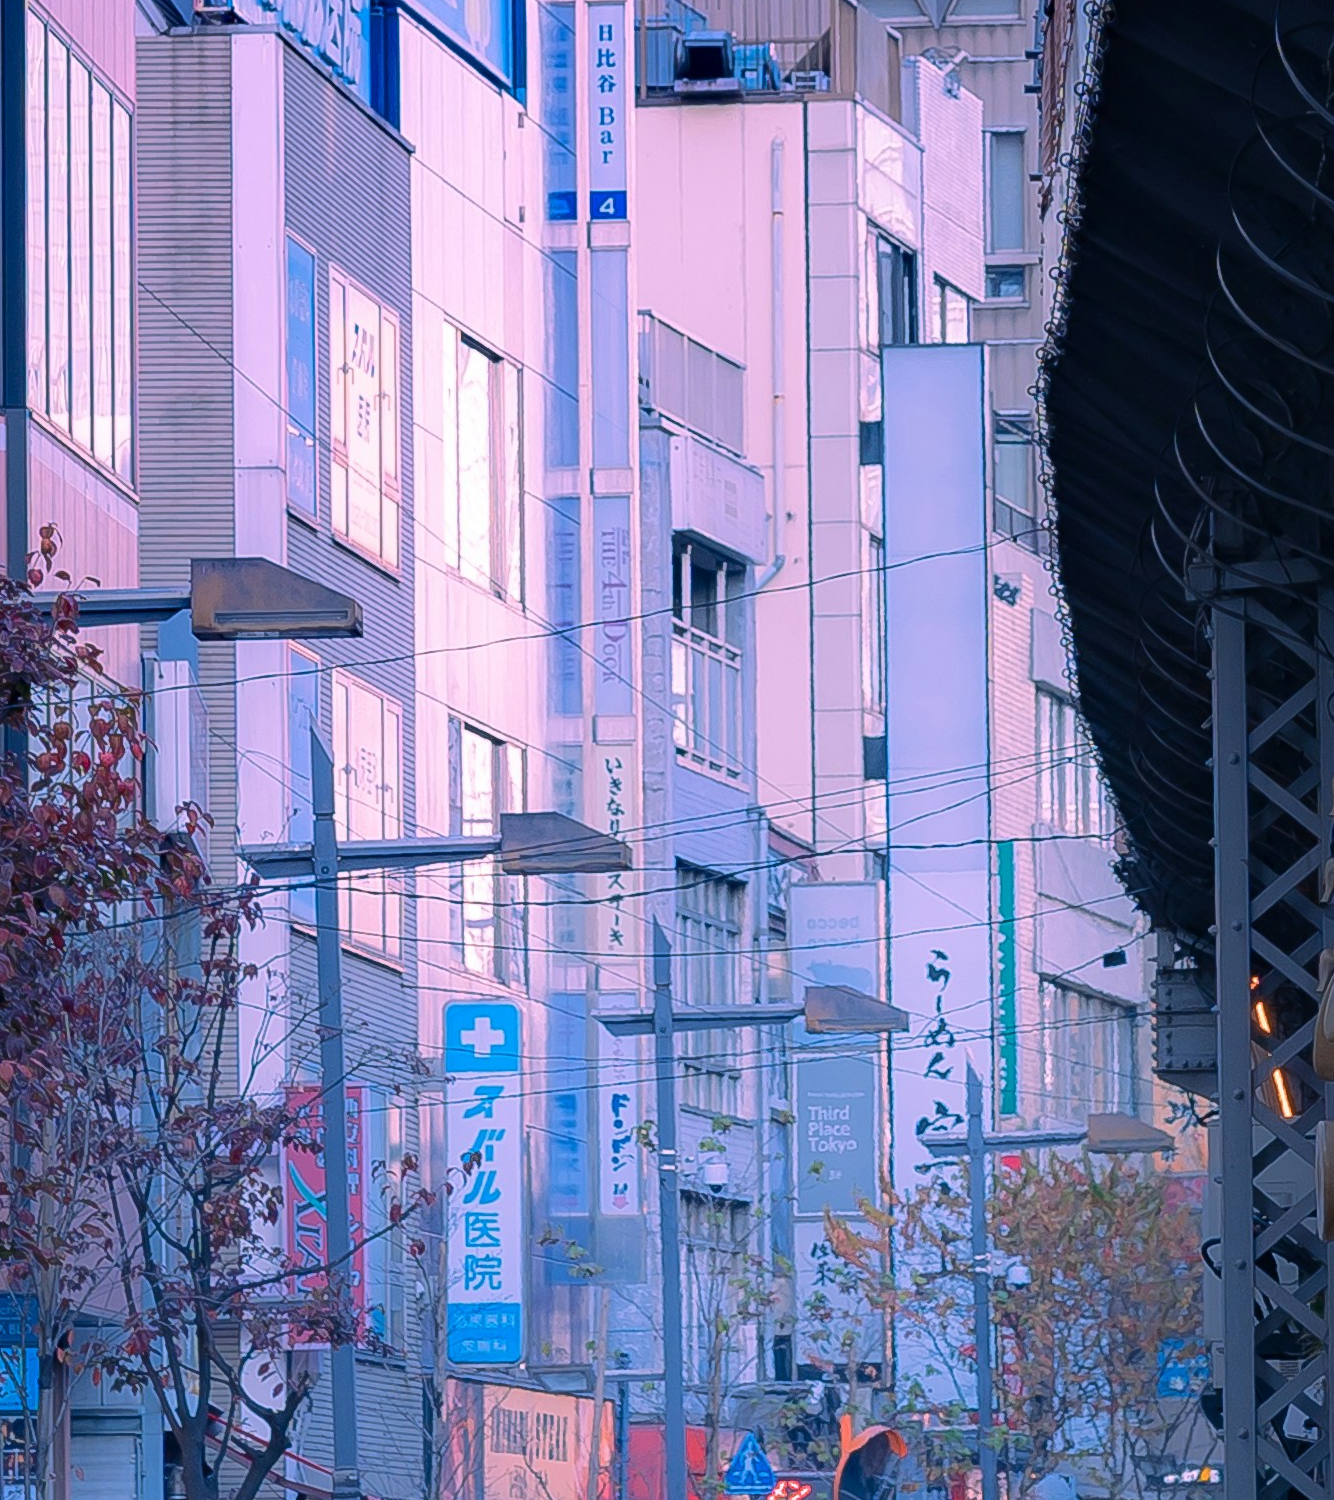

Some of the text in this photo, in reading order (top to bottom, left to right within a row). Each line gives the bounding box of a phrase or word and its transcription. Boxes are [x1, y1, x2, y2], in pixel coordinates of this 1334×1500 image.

[596, 24, 616, 165] 日比谷 Bar
[598, 197, 616, 215] 4
[807, 1104, 850, 1122] Third
[807, 1121, 851, 1139] Place
[807, 1137, 858, 1155] Tokyo
[461, 1085, 506, 1291] スバル医院
